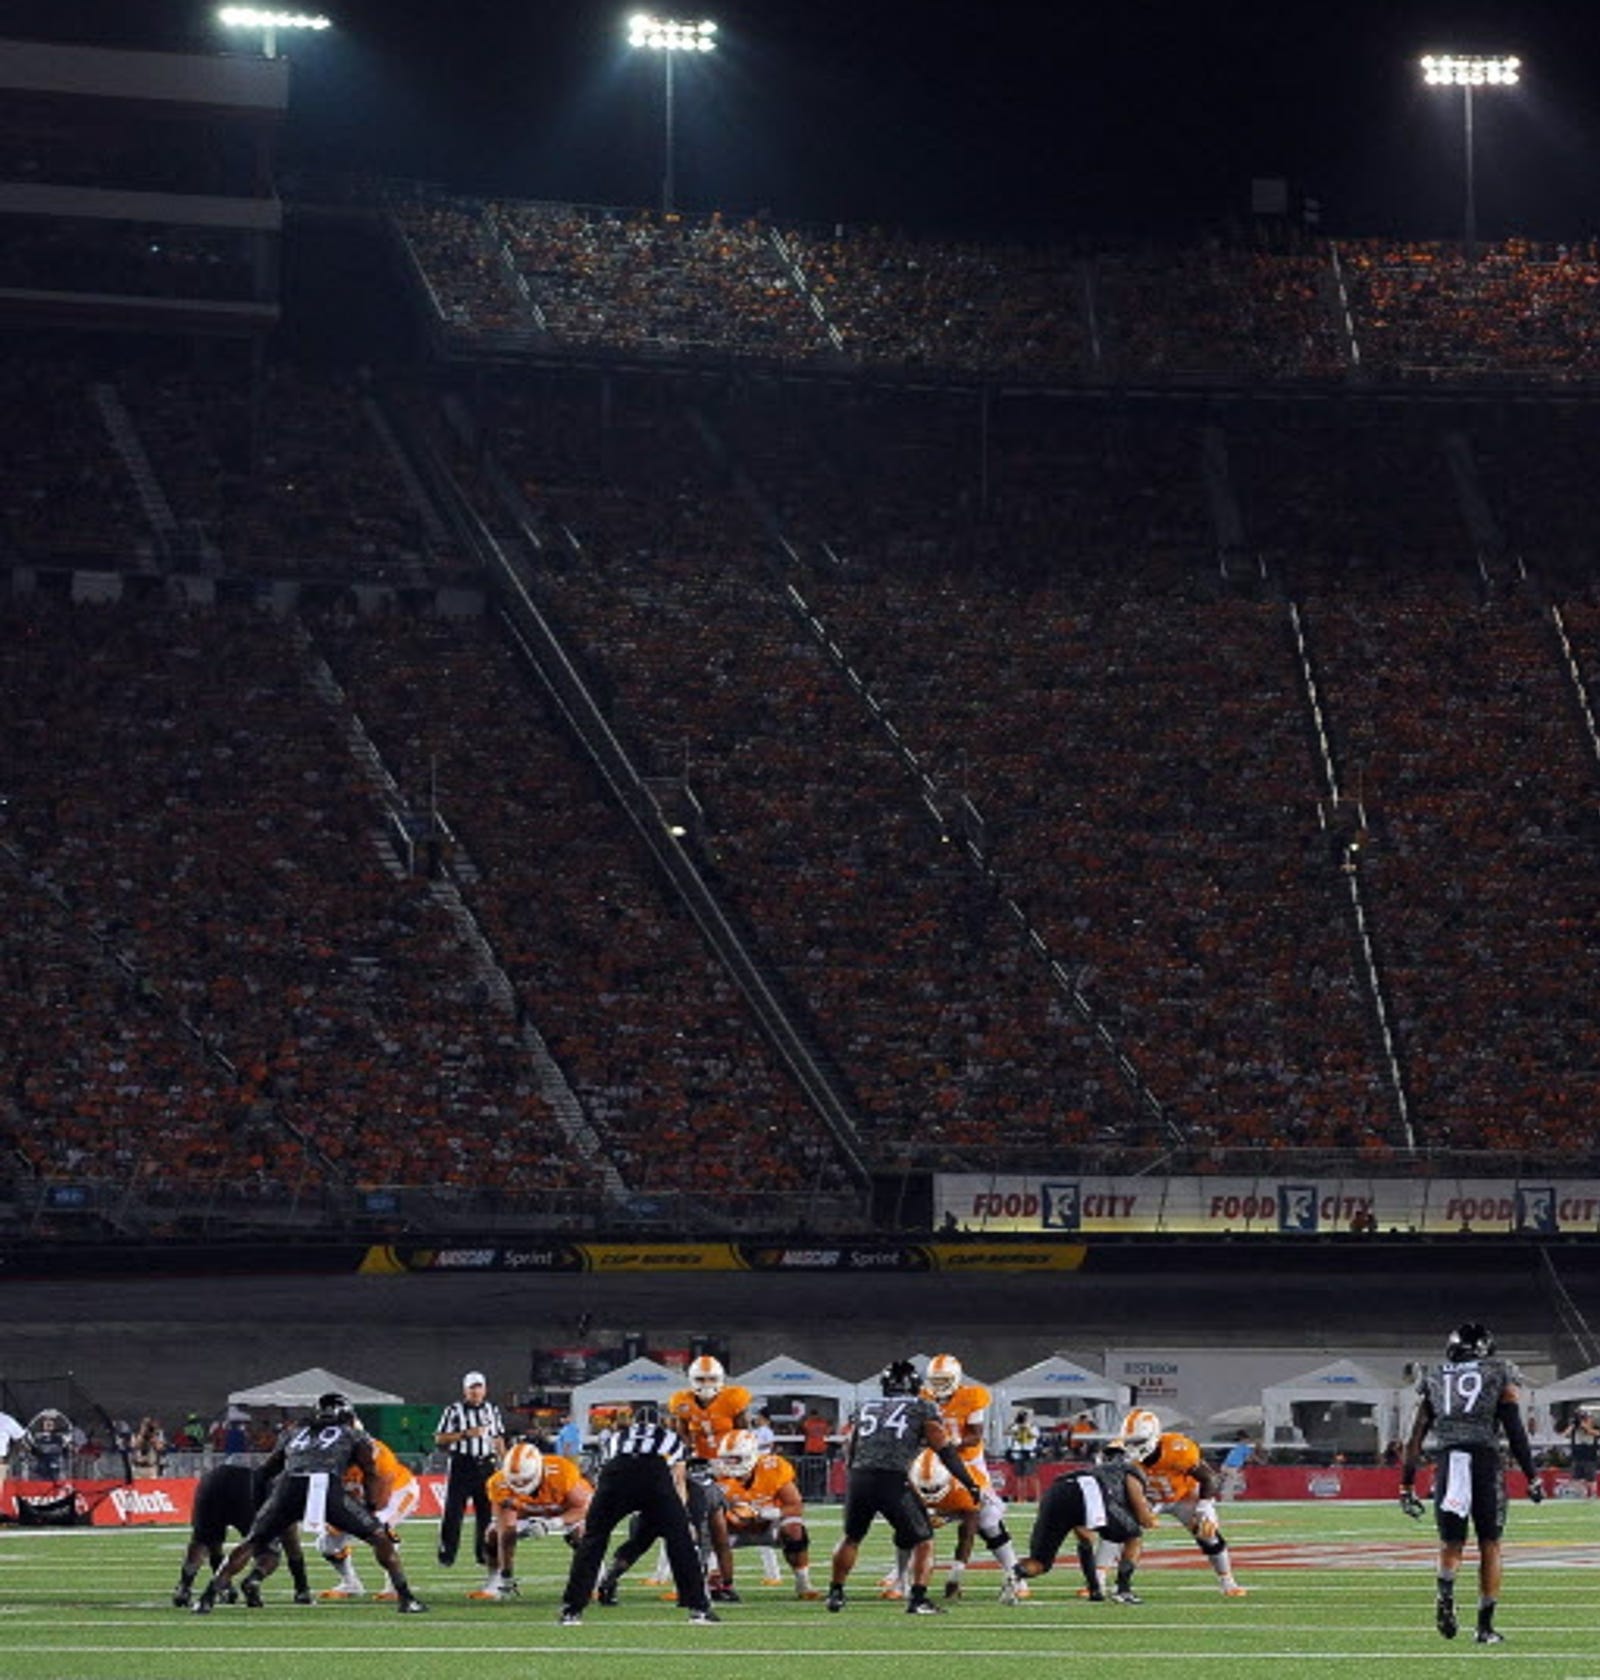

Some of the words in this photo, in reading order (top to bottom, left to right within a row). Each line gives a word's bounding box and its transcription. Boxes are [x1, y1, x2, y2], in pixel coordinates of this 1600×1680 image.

[973, 1193, 1039, 1217] FOOD
[1082, 1195, 1137, 1218] CITY
[1210, 1195, 1277, 1219] FOOD
[1445, 1198, 1514, 1221] FOOD
[434, 1249, 495, 1266] NASCAR
[504, 1251, 552, 1268] Sprint
[779, 1249, 841, 1265] NASCAR
[849, 1251, 899, 1268] Sprint
[1442, 1372, 1483, 1416] 19
[859, 1403, 908, 1440] 54
[289, 1425, 342, 1449] 49
[109, 1487, 178, 1521] Pilot
